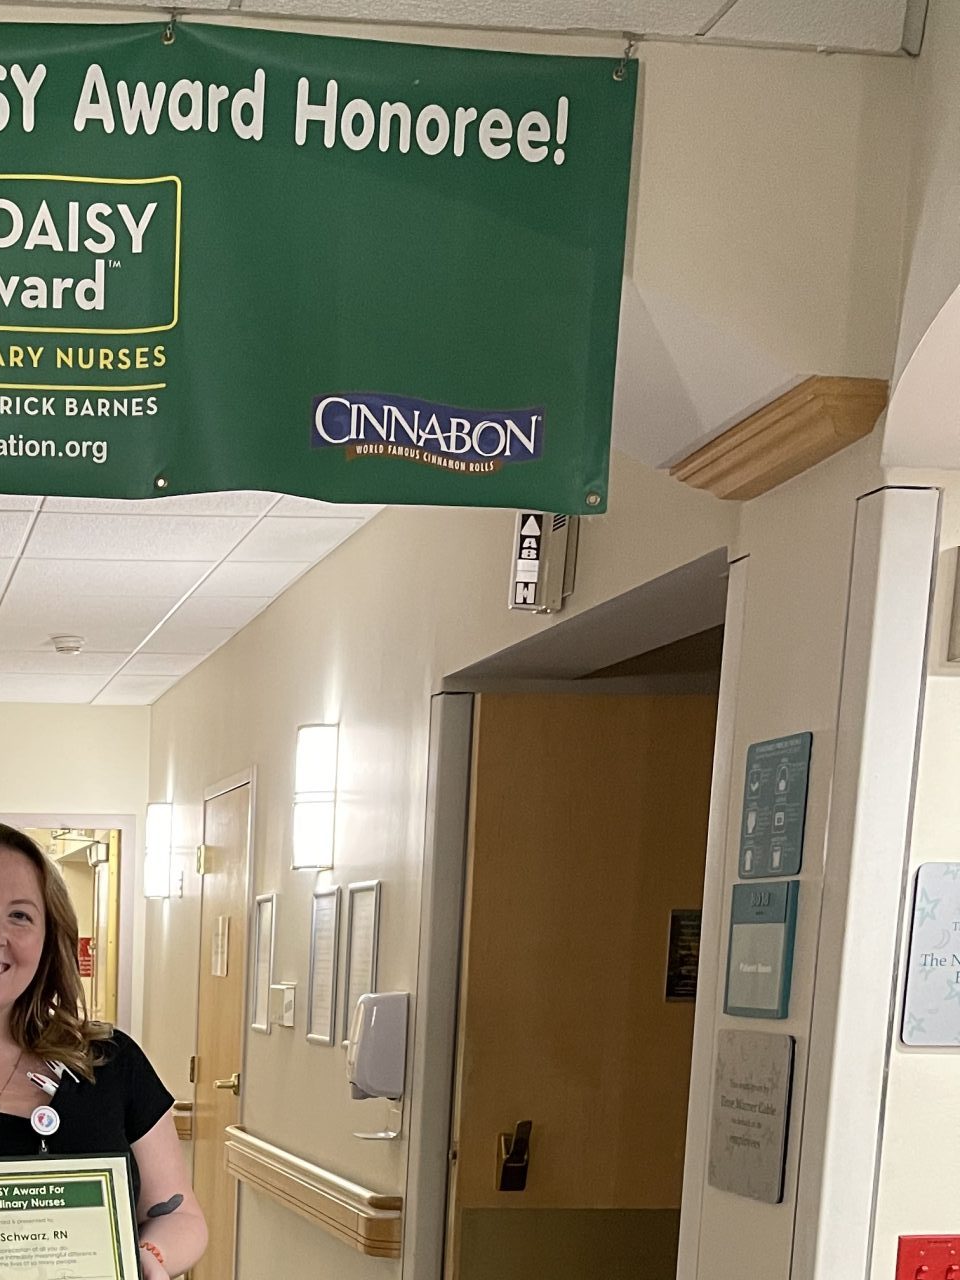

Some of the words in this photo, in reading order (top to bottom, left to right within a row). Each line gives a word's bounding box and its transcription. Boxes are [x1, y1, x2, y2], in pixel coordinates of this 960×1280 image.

[74, 63, 266, 141] Award
[295, 77, 569, 166] Honoree!
[56, 345, 167, 370] NURSES
[65, 396, 159, 417] BARNES
[355, 445, 384, 454] WORLD
[388, 445, 420, 460] FAMOUS
[423, 453, 466, 471] CINNAMON
[469, 461, 494, 472] ROLLS
[920, 953, 947, 967] The
[12, 1186, 46, 1196] Award
[49, 1185, 65, 1194] For
[31, 1198, 65, 1208] Nurses
[0, 1231, 50, 1242] Schwarz,
[53, 1230, 68, 1240] RN
